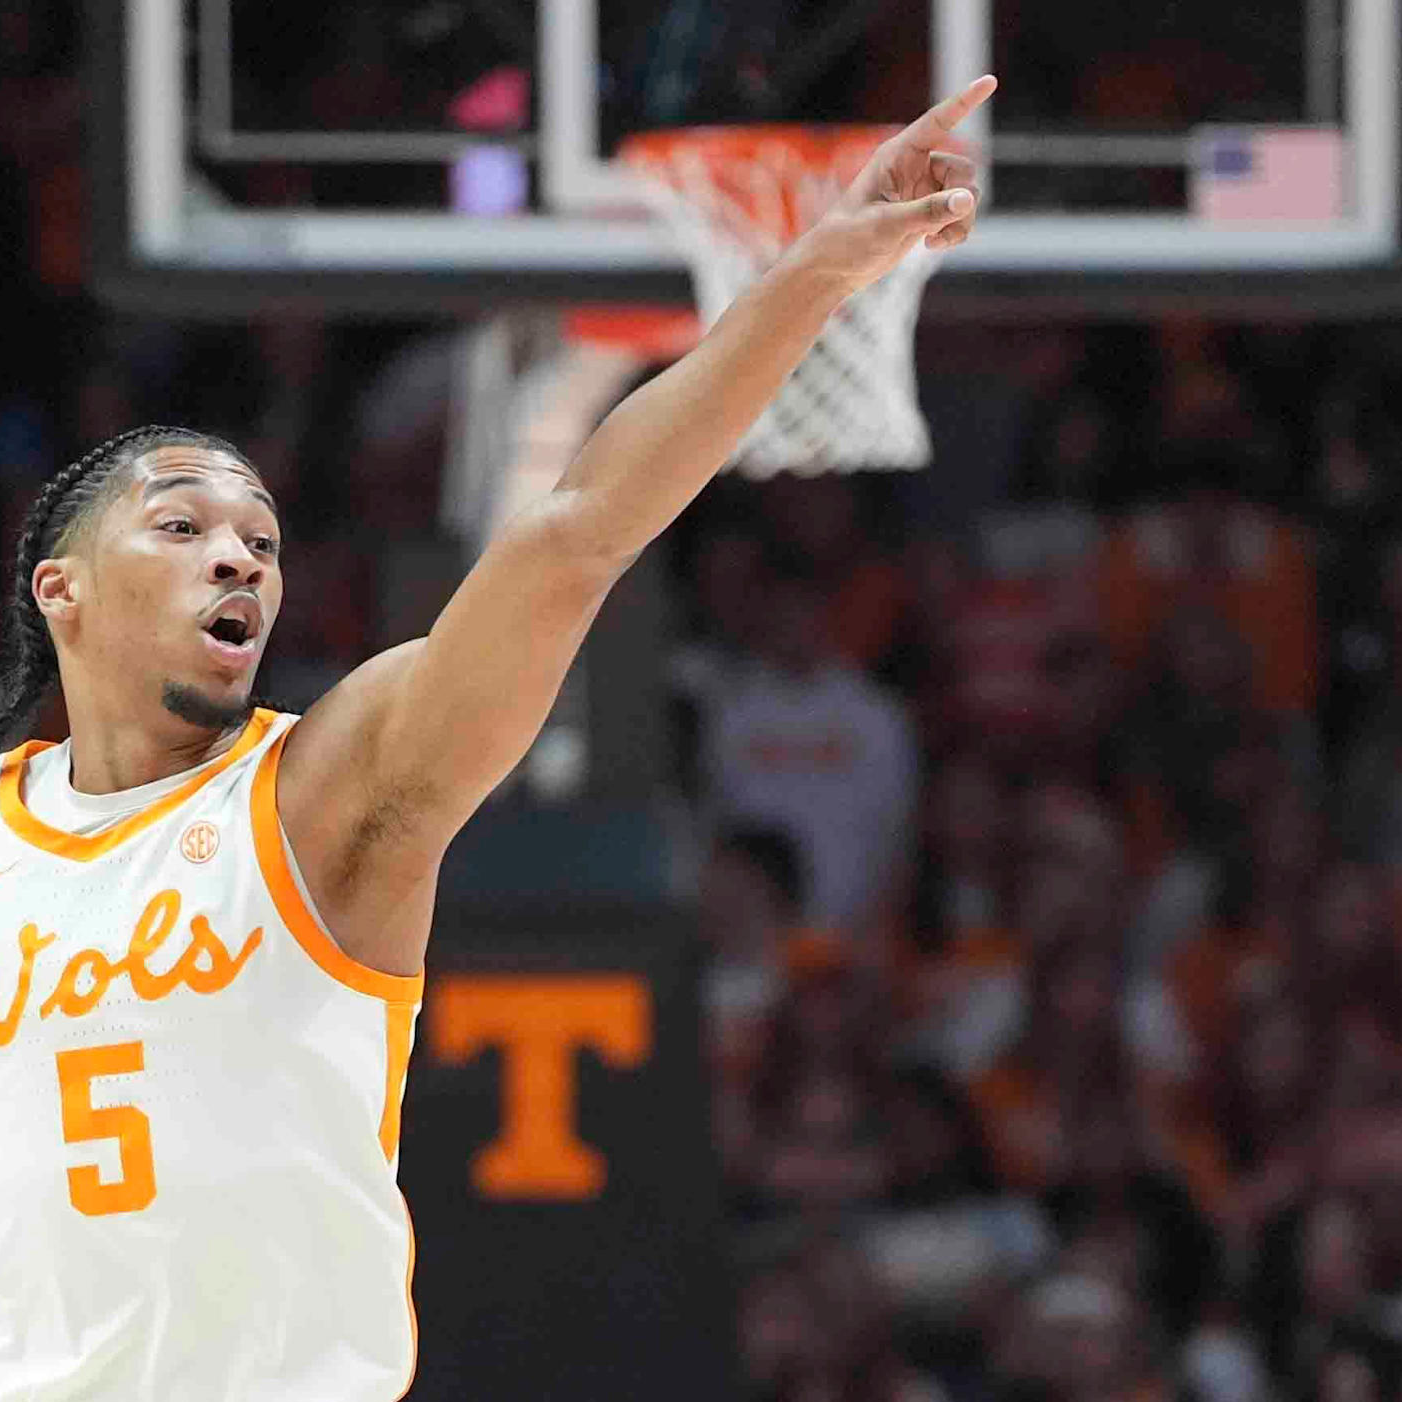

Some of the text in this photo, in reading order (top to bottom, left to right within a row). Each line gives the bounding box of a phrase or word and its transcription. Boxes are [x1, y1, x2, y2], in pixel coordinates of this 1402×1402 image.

[183, 823, 217, 861] SEC
[55, 1040, 157, 1217] 5
[431, 972, 655, 1202] T
